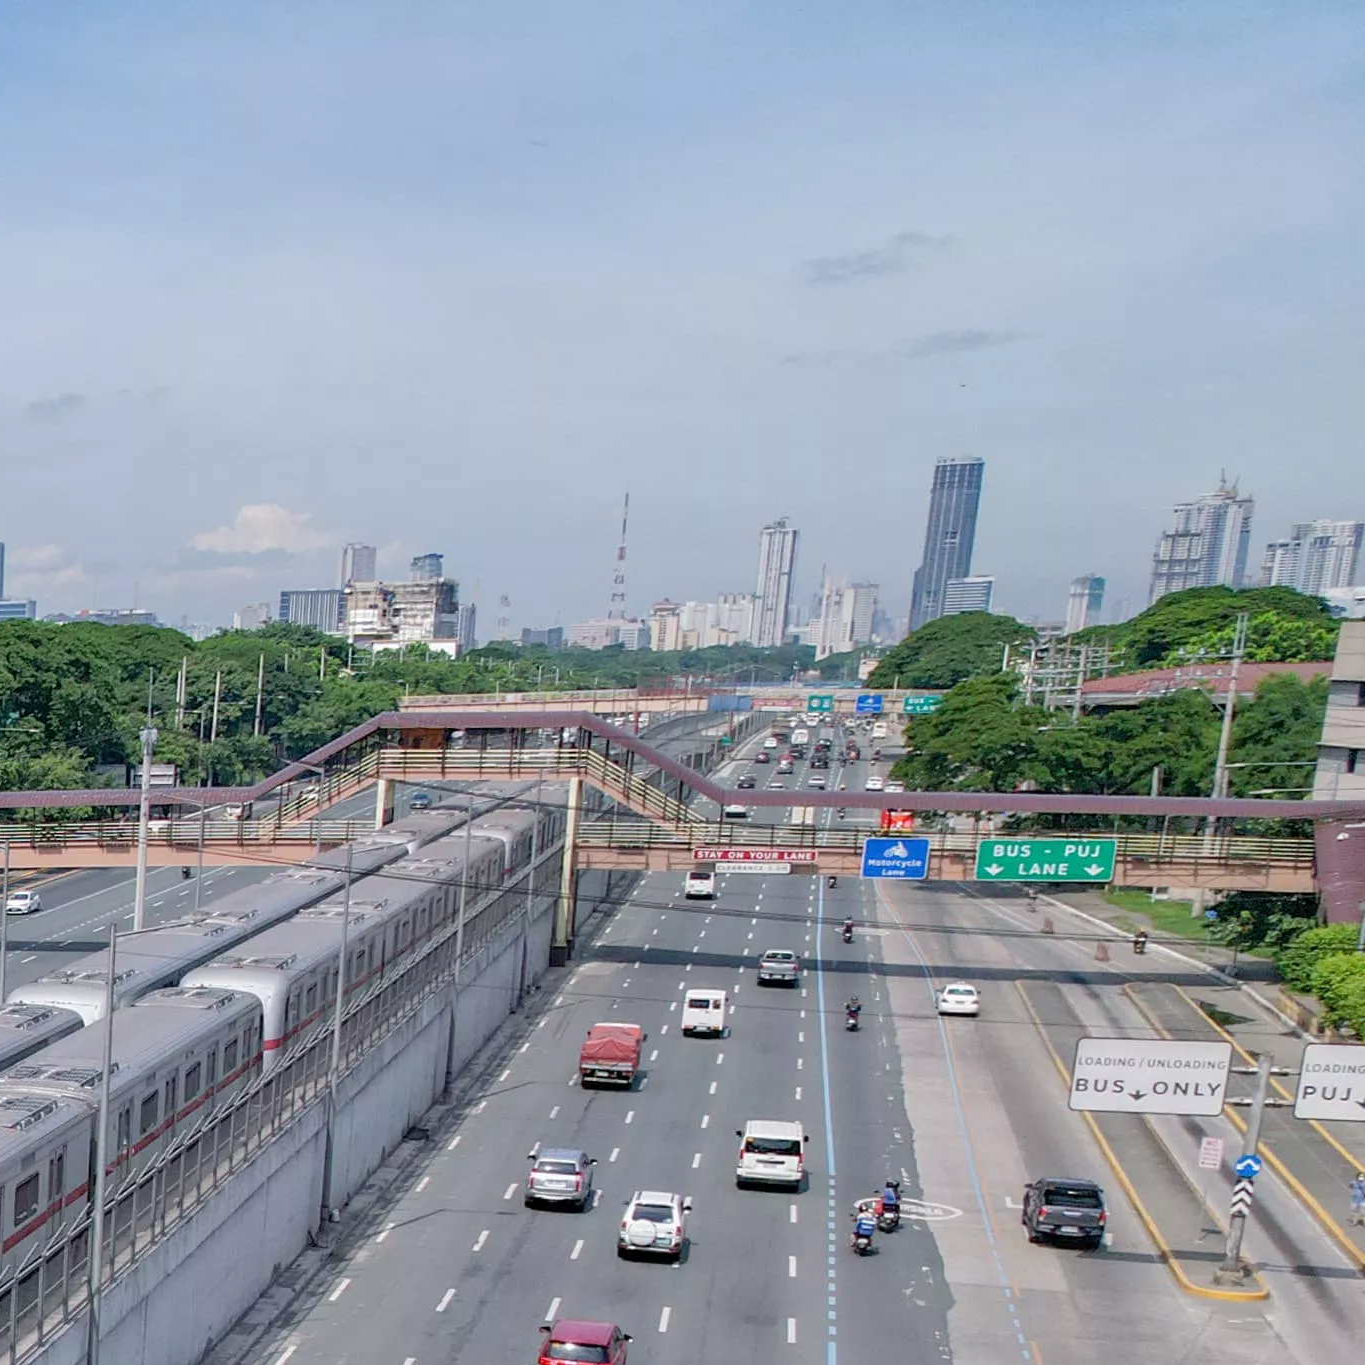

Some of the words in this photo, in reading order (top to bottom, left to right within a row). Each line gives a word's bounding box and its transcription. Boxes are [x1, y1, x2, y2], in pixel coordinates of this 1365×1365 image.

[728, 851, 744, 859] ON
[750, 852, 779, 860] YOUR
[993, 844, 1032, 858] BUS
[1064, 844, 1101, 858] PUJ
[868, 859, 922, 868] Motorcycle
[1018, 863, 1069, 876] LANE
[882, 868, 906, 876] Lane
[1078, 1056, 1136, 1068] LOADING
[1147, 1059, 1227, 1070] UNLOADING
[1305, 1063, 1365, 1074] LOADING
[1075, 1078, 1125, 1093] BUS
[1152, 1081, 1221, 1097] ONLY
[1302, 1085, 1352, 1102] PUJ
